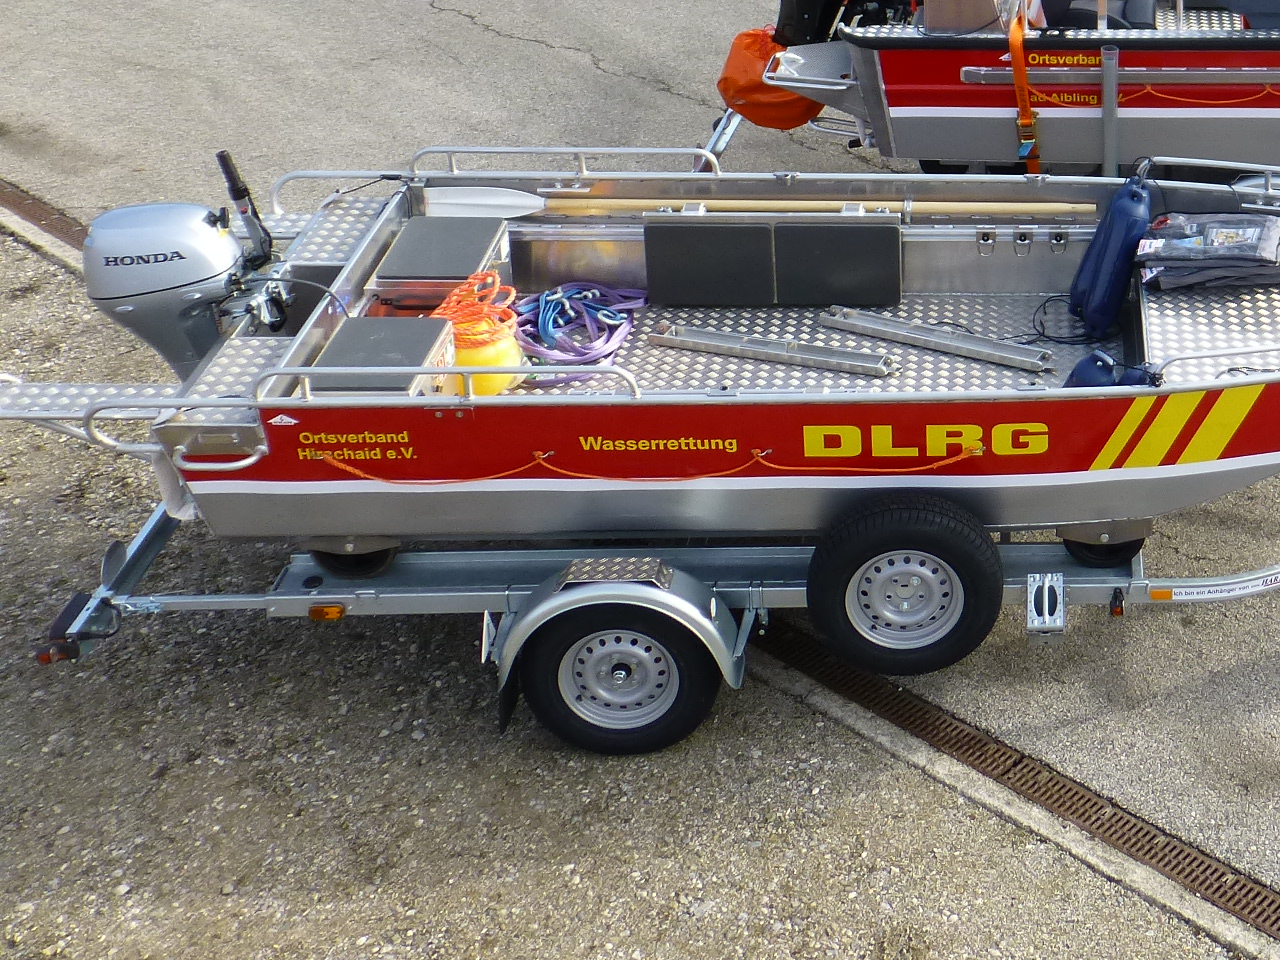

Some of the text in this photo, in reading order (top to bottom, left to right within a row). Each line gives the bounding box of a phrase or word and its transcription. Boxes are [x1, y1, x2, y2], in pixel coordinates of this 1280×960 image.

[1028, 53, 1102, 65] Ortsverban
[1051, 93, 1098, 105] Aibling
[103, 250, 187, 267] HONDA
[298, 430, 409, 444] Ortsverband
[802, 422, 1049, 457] DLRG
[578, 436, 738, 453] Wasserrettung
[386, 447, 418, 460] e.V.
[1206, 587, 1237, 596] Anhänger
